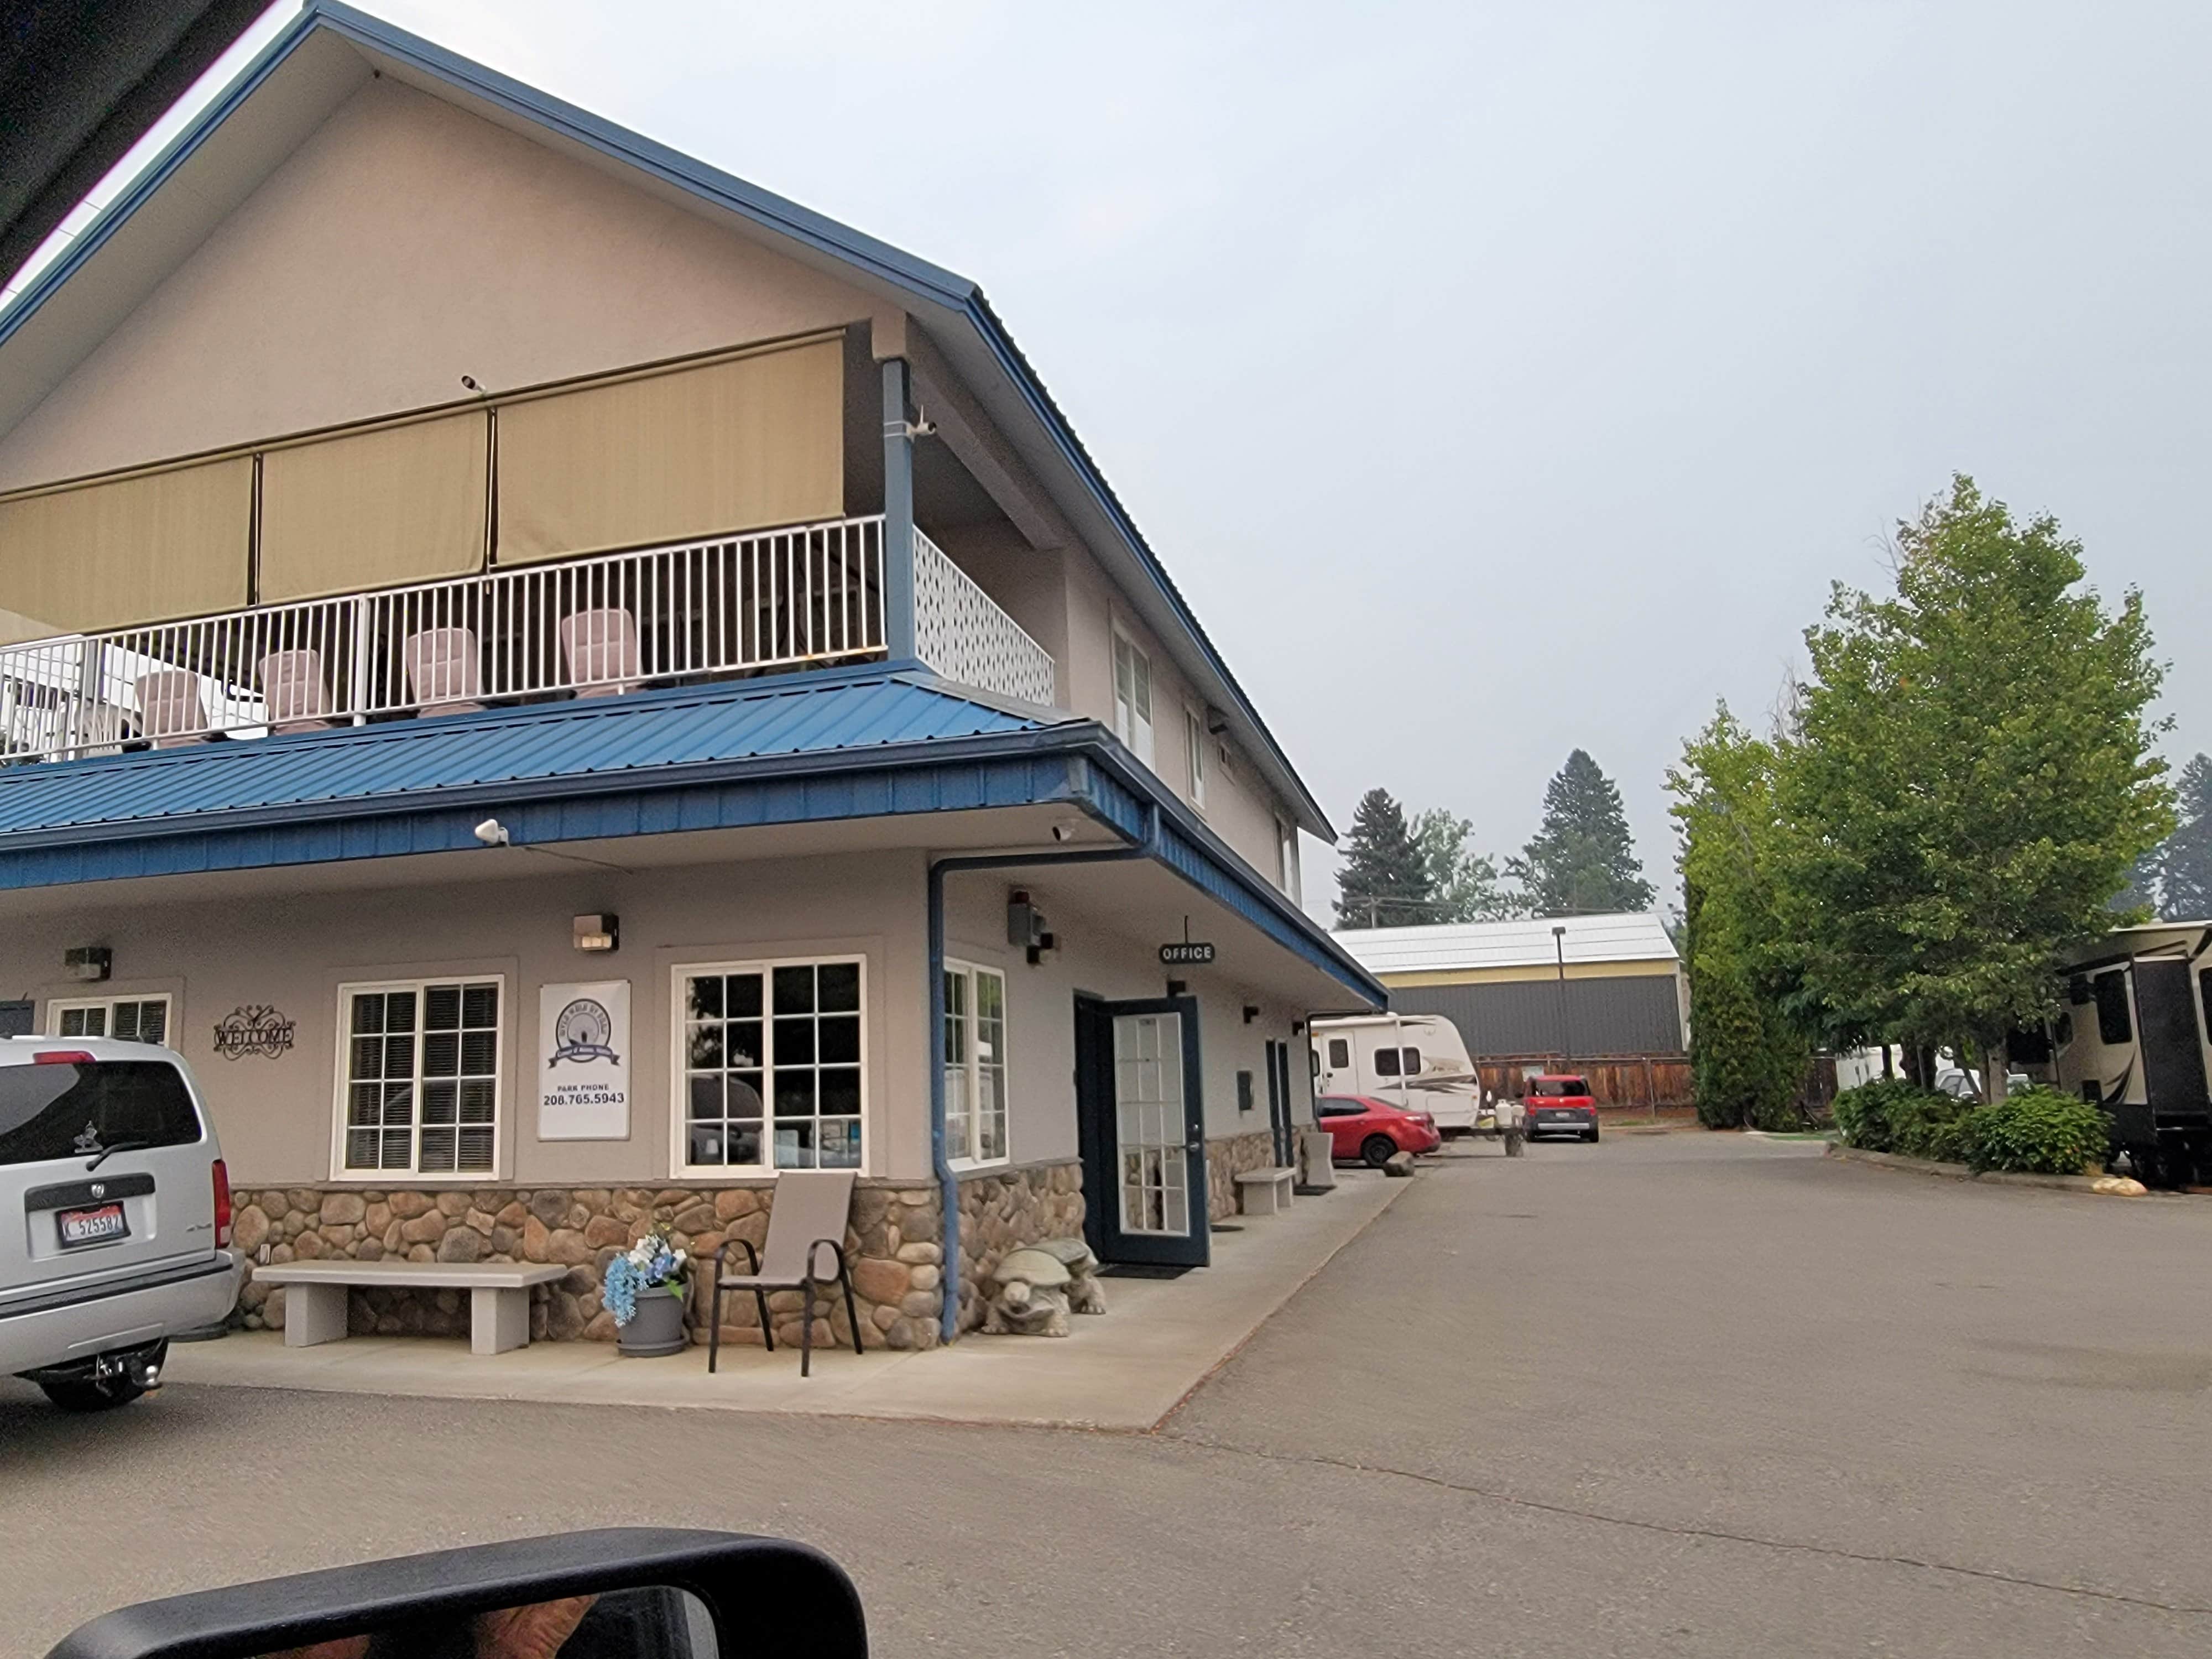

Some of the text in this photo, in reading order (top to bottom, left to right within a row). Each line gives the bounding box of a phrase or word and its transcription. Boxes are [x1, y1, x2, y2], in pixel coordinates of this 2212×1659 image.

[1162, 946, 1212, 960] OFFICE
[217, 1026, 292, 1046] WELCOME
[544, 1092, 624, 1105] 208.765.5943
[79, 1215, 121, 1235] 525582
